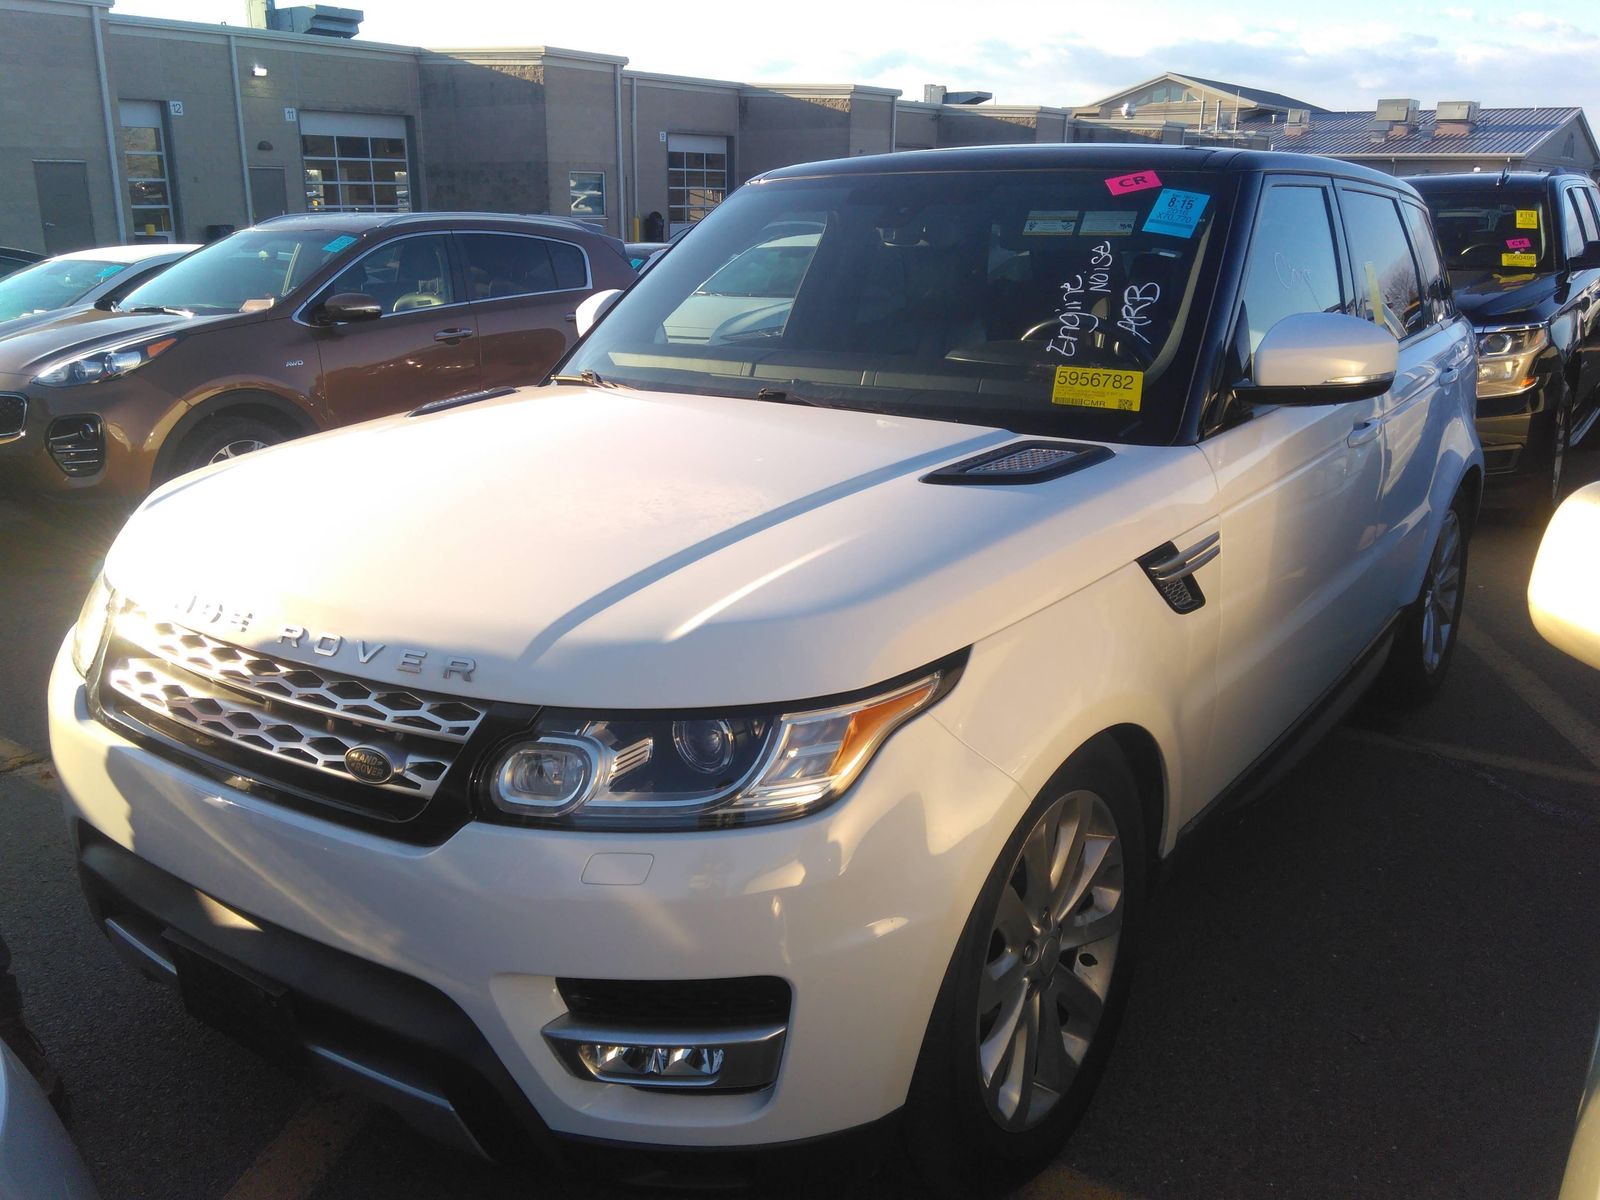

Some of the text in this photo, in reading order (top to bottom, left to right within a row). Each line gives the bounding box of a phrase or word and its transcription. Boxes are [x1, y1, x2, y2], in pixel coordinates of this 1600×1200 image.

[171, 103, 183, 114] 12
[286, 109, 295, 119] 11
[1119, 175, 1149, 188] CR
[1046, 274, 1099, 357] Engine
[286, 360, 304, 368] AWD
[1057, 370, 1134, 390] 5956782
[1083, 399, 1106, 407] CMR
[276, 624, 477, 683] ROVER
[355, 762, 384, 777] ROVER
